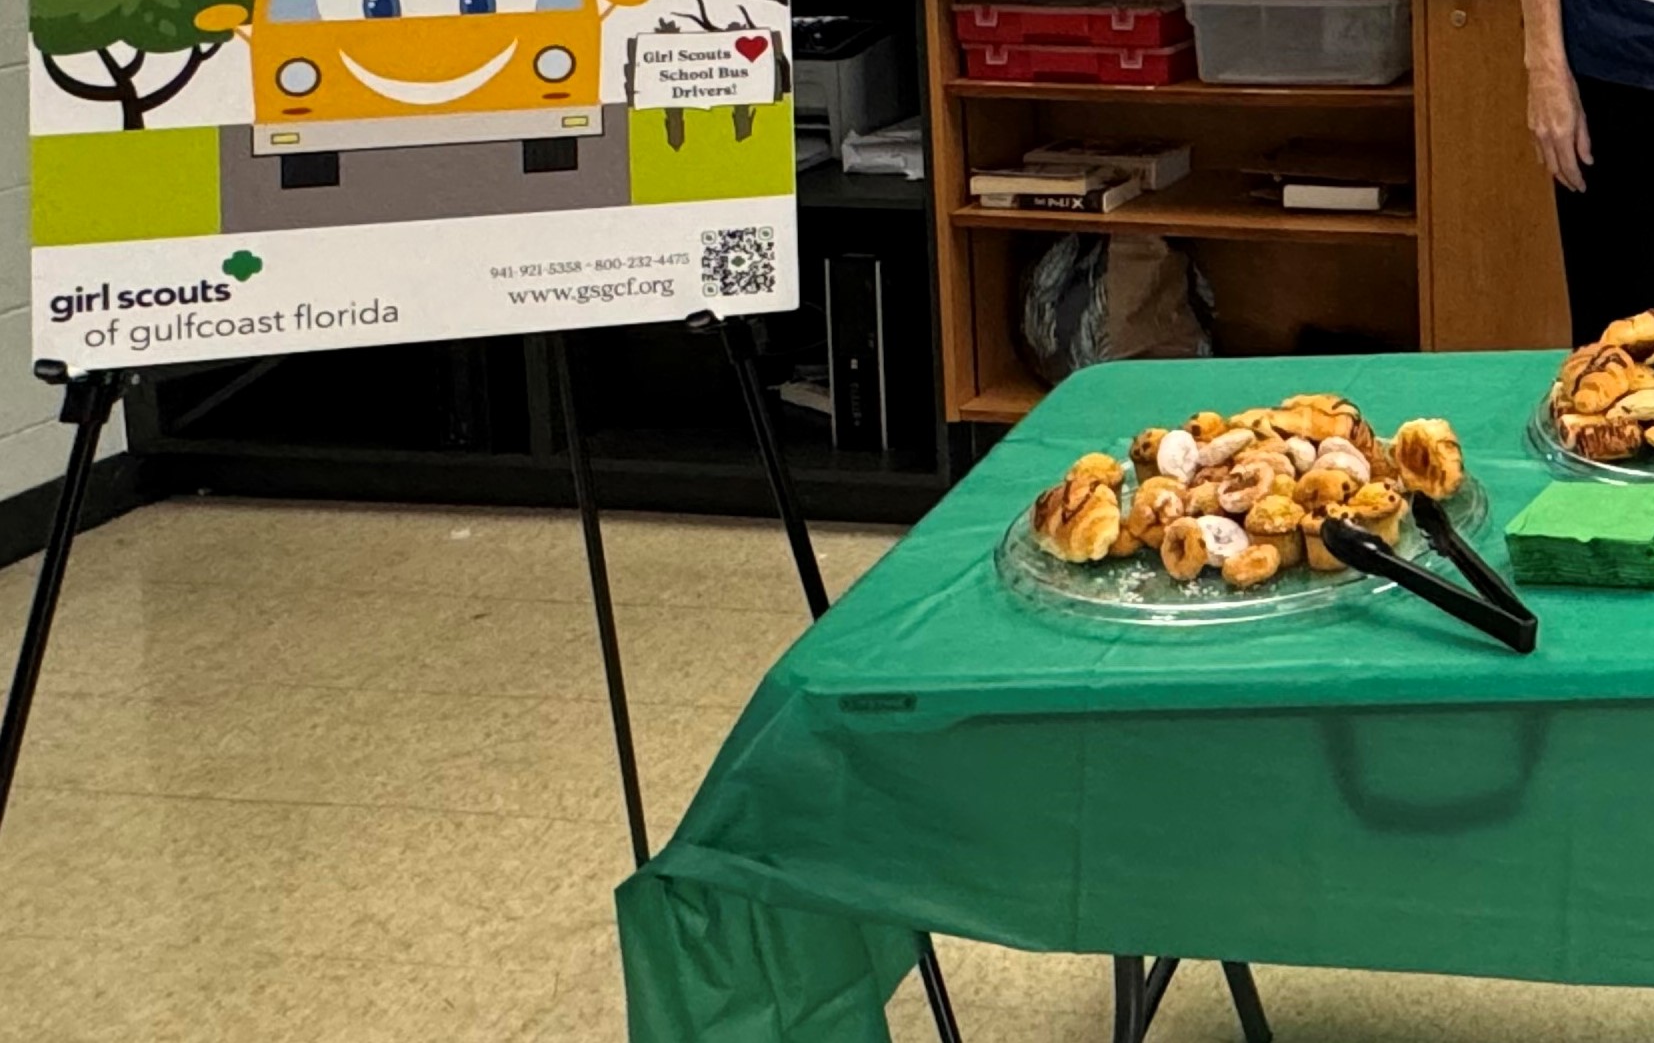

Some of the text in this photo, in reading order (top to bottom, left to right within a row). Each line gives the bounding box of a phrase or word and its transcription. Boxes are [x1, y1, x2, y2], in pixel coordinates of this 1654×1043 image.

[643, 48, 732, 64] Girl Scouts
[658, 66, 750, 82] School Bus
[671, 84, 738, 100] Drivers!
[49, 274, 232, 324] girl scouts
[507, 277, 675, 305] www.gsgcf.org
[83, 297, 400, 351] of gulfcoast florida
